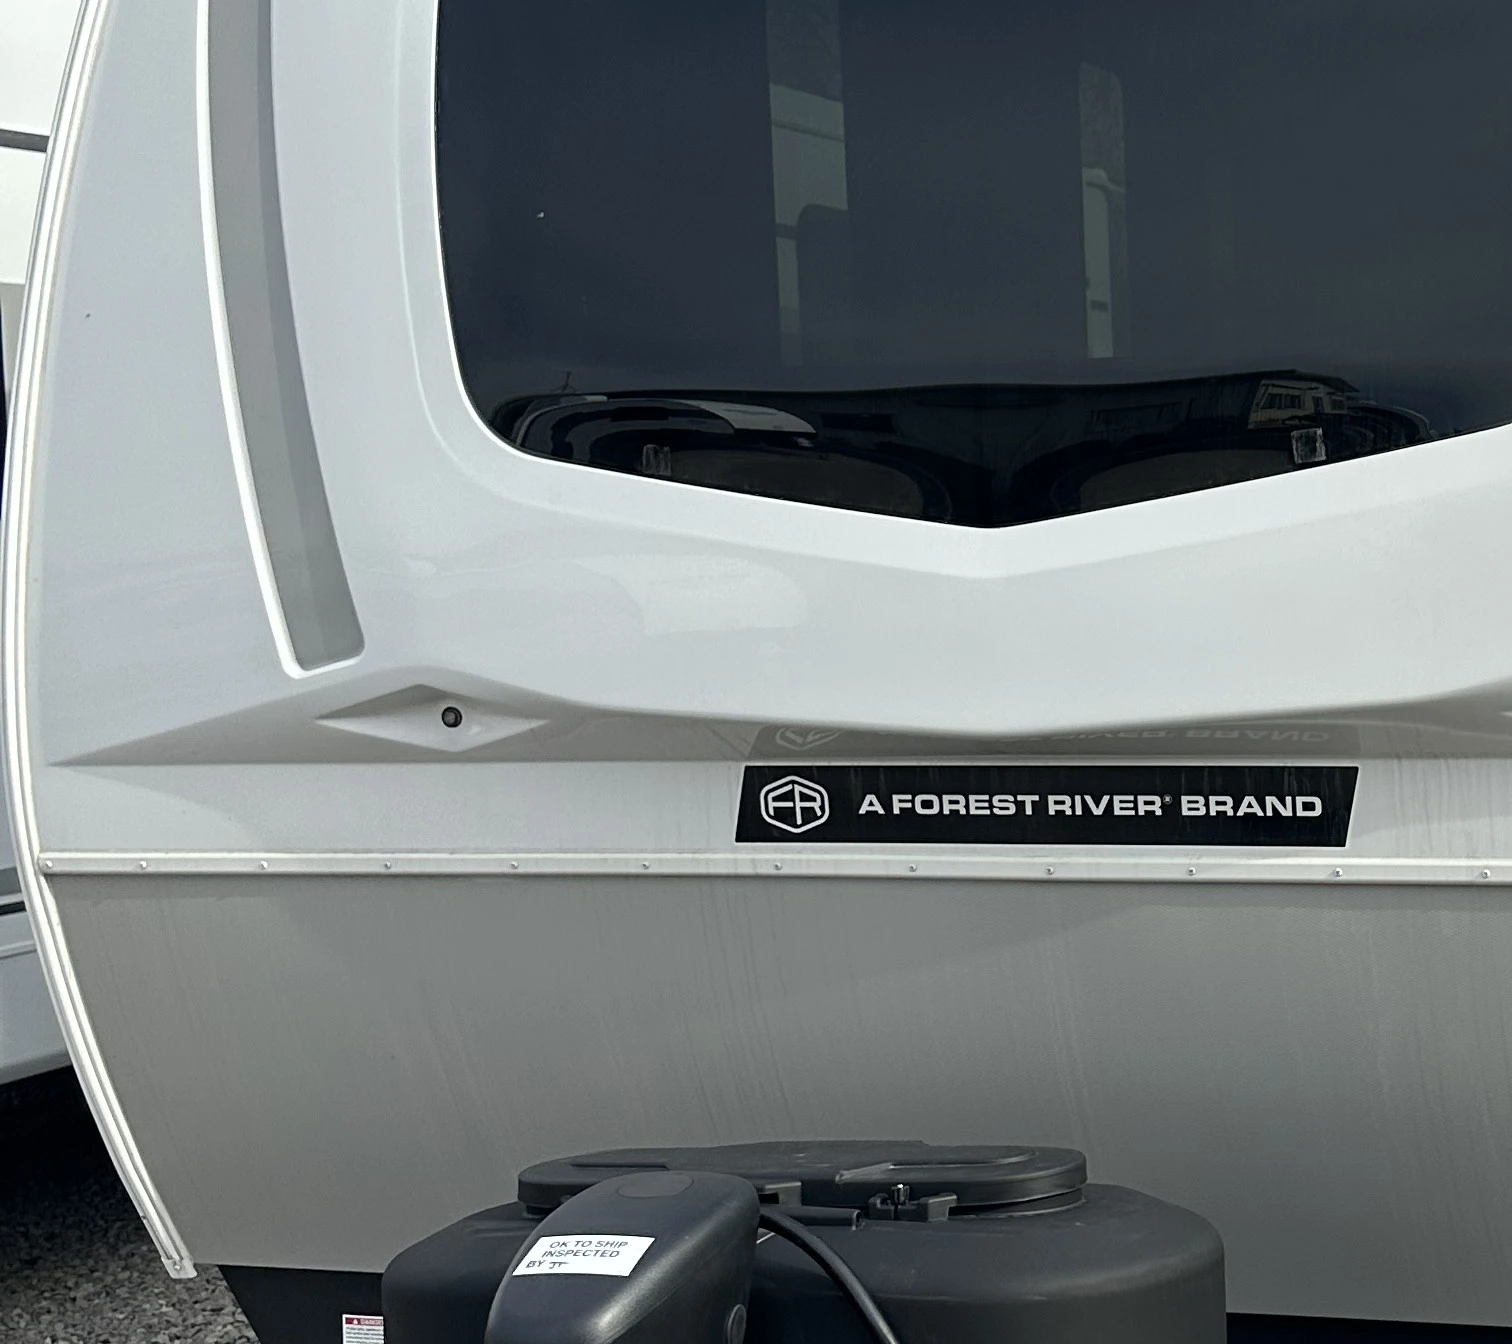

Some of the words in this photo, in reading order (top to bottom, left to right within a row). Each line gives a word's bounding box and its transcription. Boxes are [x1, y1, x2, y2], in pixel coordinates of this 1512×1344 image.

[858, 794, 885, 815] A
[892, 794, 1039, 816] FOREST
[1180, 795, 1323, 817] BRAND
[549, 1240, 569, 1249] OK
[573, 1240, 592, 1248] TO
[594, 1240, 629, 1248] SHIP
[541, 1249, 620, 1258] INSPECTED
[525, 1260, 547, 1269] BY
